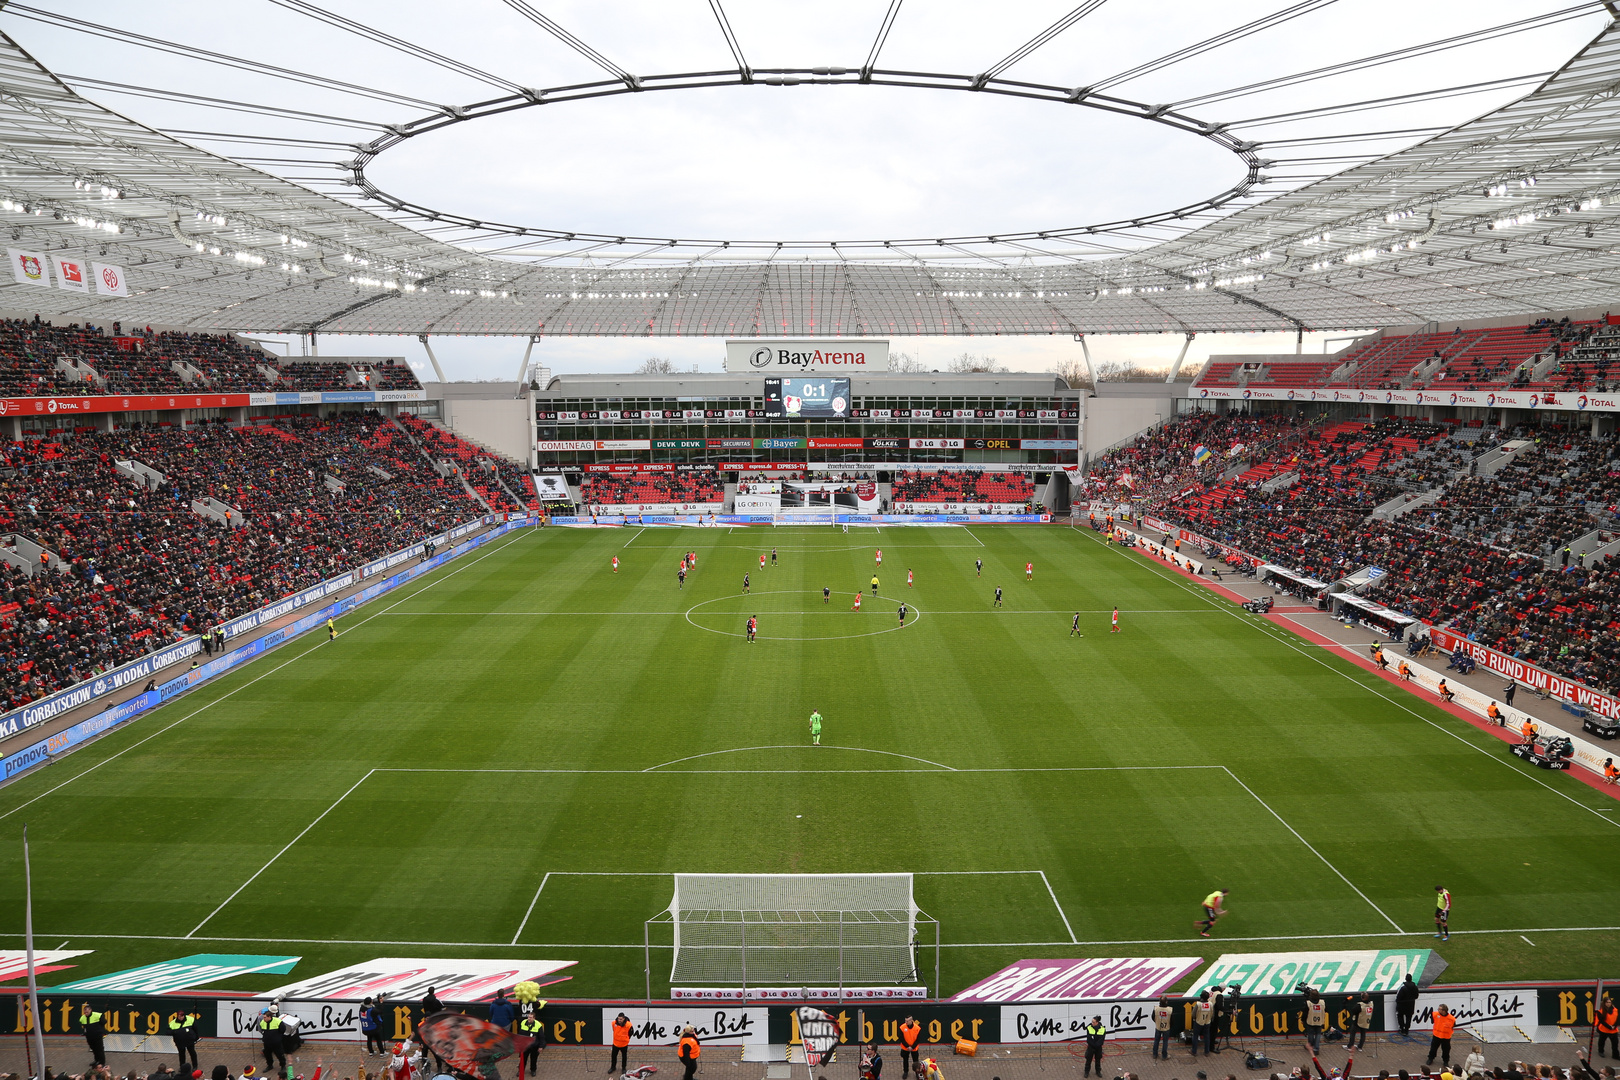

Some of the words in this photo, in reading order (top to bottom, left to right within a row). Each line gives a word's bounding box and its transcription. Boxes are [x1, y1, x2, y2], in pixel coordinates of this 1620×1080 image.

[777, 350, 866, 368] BayArena
[803, 384, 826, 397] 0:1
[1497, 396, 1516, 404] TOTAL
[1540, 397, 1563, 406] TAL
[1590, 398, 1616, 407] TOTAL
[304, 589, 324, 603] WODKA
[232, 616, 257, 635] WODKA
[113, 664, 150, 688] WODKA
[152, 640, 200, 670] GORBATSCHOW
[160, 668, 202, 701] pronovaBKK
[1489, 653, 1524, 679] RUND
[1526, 668, 1546, 689] UM
[1550, 677, 1574, 700] DIE
[1578, 687, 1620, 720] WERK
[23, 686, 91, 727] GORBATSCHOW
[82, 718, 104, 736] Mein
[105, 695, 148, 724] Heimvorteil
[5, 731, 69, 777] pronovaBKK
[1514, 748, 1523, 756] sky
[1530, 756, 1540, 765] sky
[521, 1003, 533, 1013] 04
[1488, 993, 1525, 1016] Bit
[14, 999, 201, 1035] Biturg
[322, 1006, 358, 1028] Bit
[630, 1022, 667, 1040] itte
[673, 1021, 709, 1037] en
[714, 1011, 754, 1034] Bit
[789, 1010, 984, 1044] tbuger
[1017, 1013, 1064, 1039] Bitte
[1070, 1016, 1105, 1033] ei
[1110, 1005, 1148, 1028] Bit
